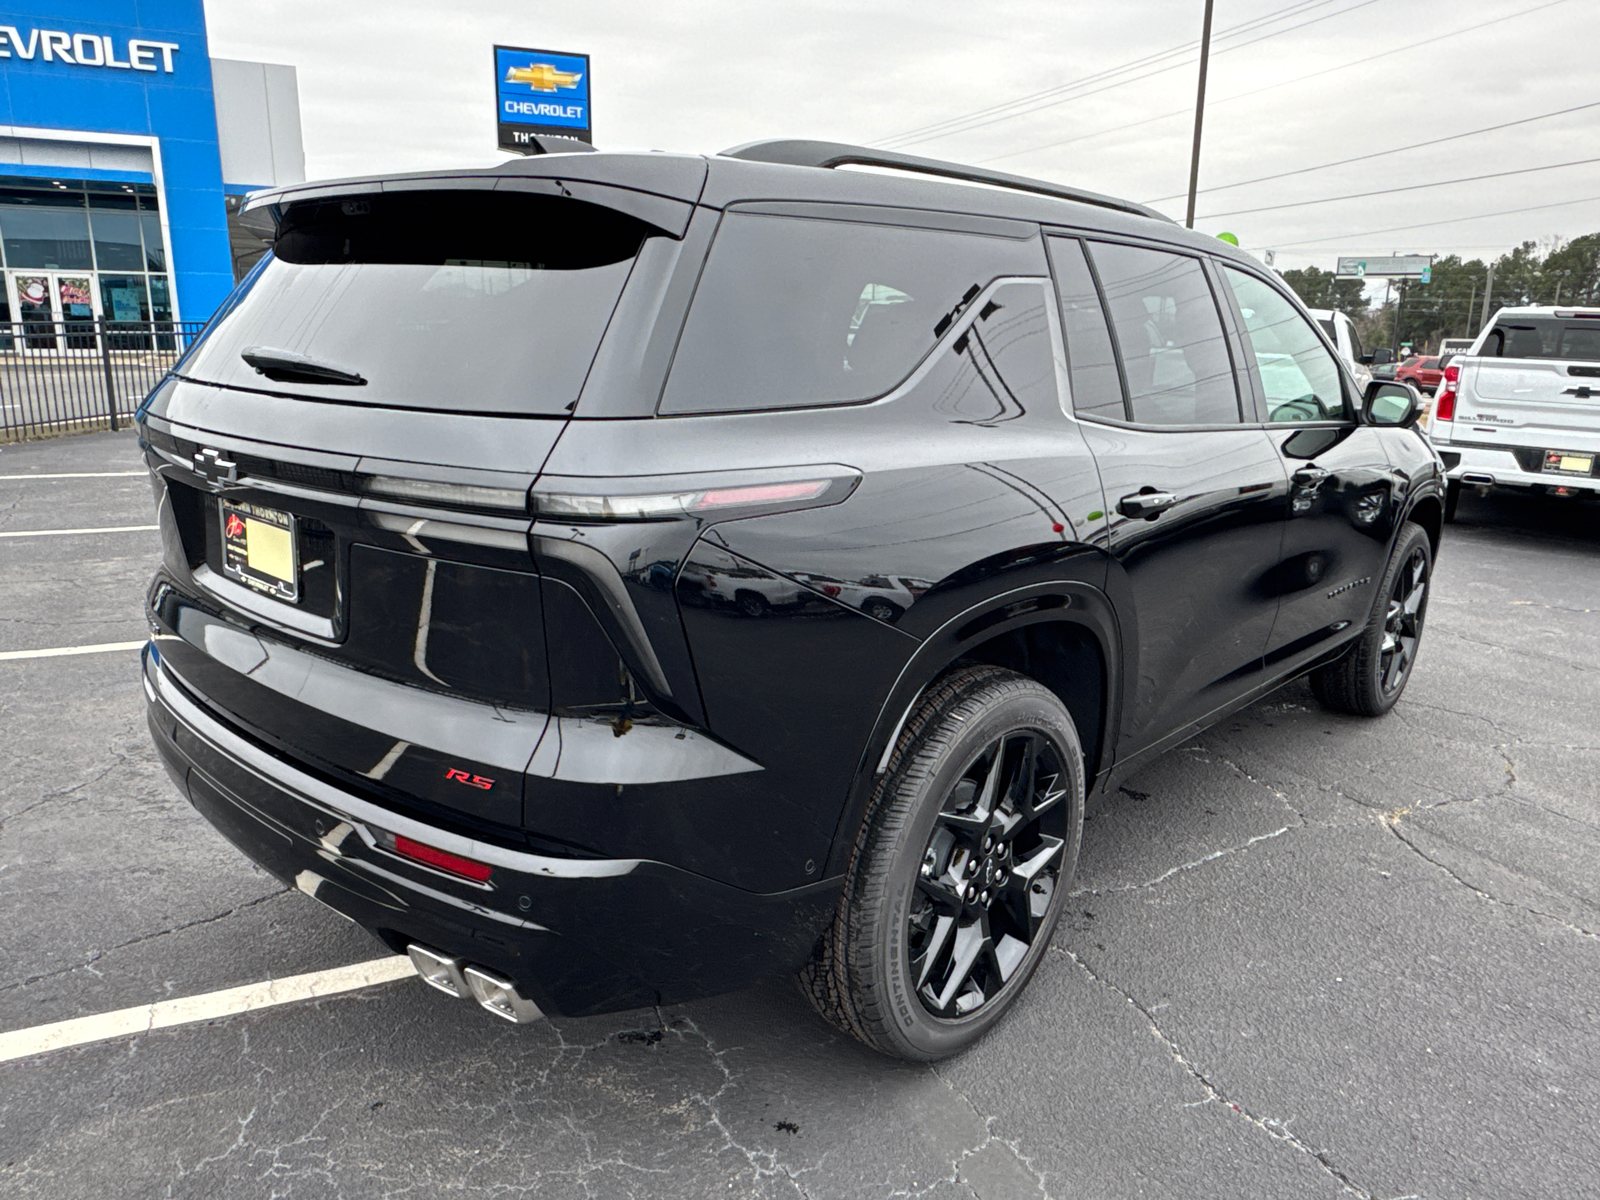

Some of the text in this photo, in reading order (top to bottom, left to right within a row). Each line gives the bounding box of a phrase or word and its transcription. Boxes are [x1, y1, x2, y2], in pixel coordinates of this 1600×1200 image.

[505, 101, 583, 118] CHEVROLET
[1458, 414, 1515, 424] SILVERADO
[445, 767, 496, 790] RS
[890, 883, 914, 1027] CONTINENTAL
